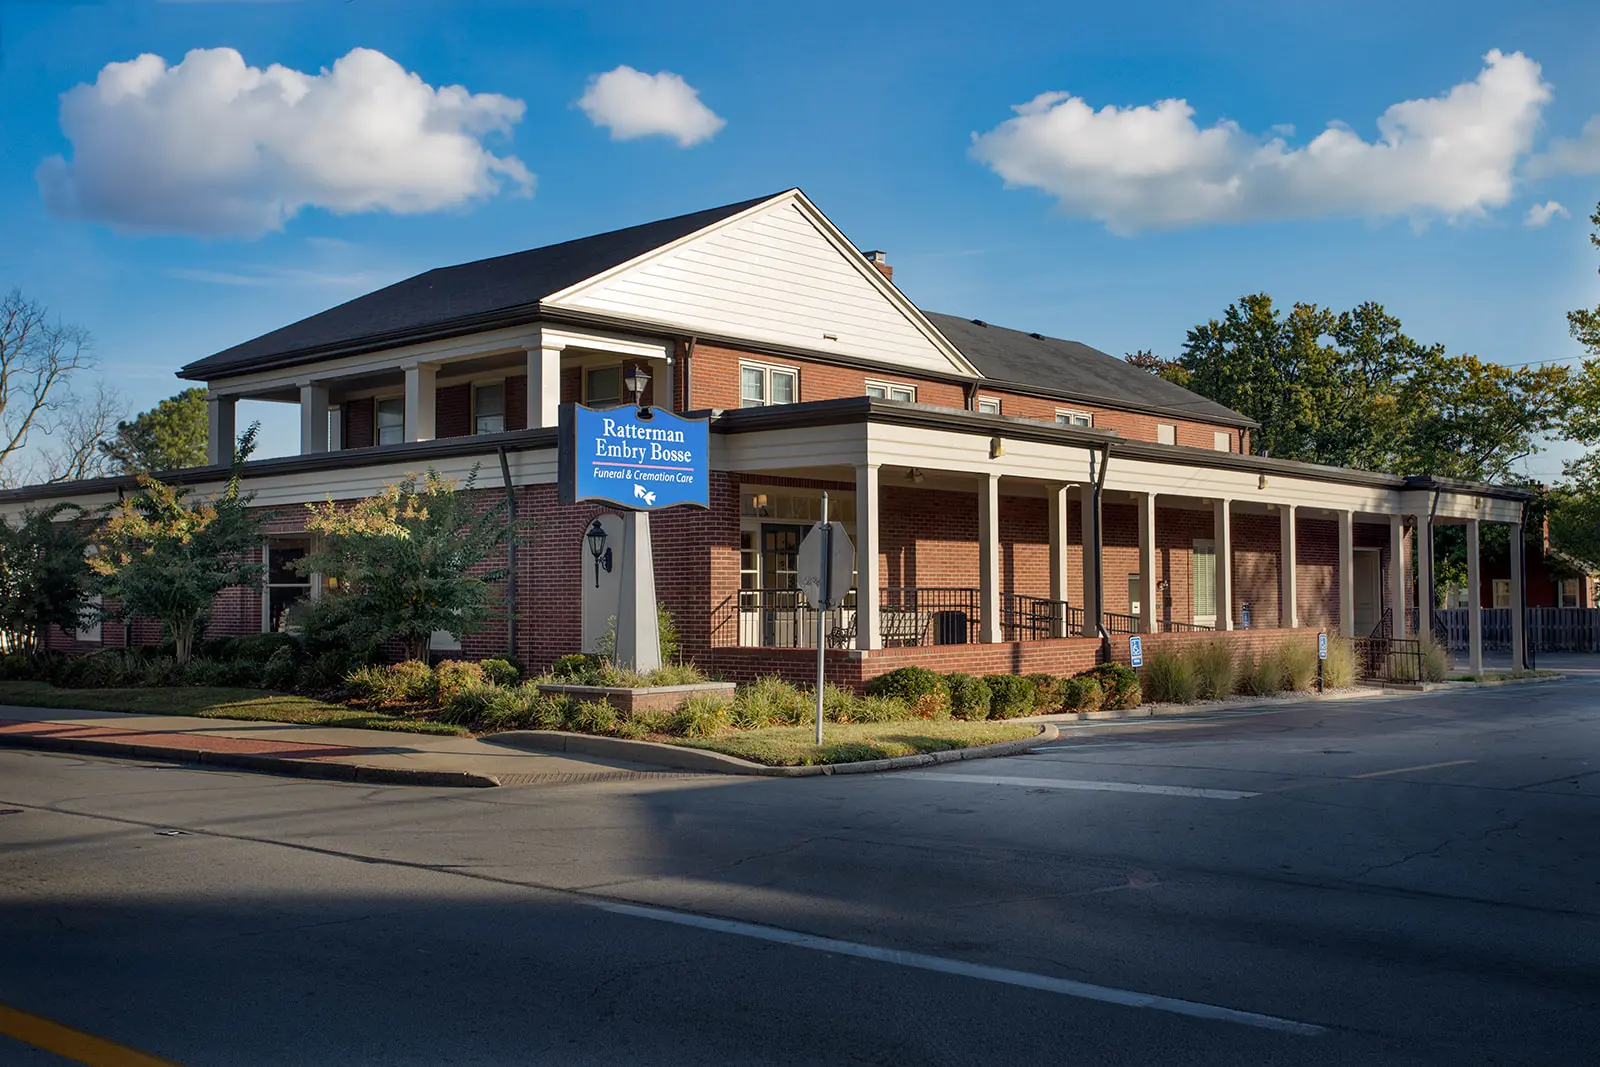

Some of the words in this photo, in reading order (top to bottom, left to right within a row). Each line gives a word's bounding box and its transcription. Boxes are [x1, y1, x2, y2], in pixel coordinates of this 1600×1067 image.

[602, 418, 684, 442] Ratterman
[595, 438, 646, 463] Embry
[650, 442, 692, 462] Bosse
[593, 467, 625, 479] Funeral
[625, 470, 632, 480] &
[633, 470, 675, 482] Cremation
[676, 473, 693, 483] Care
